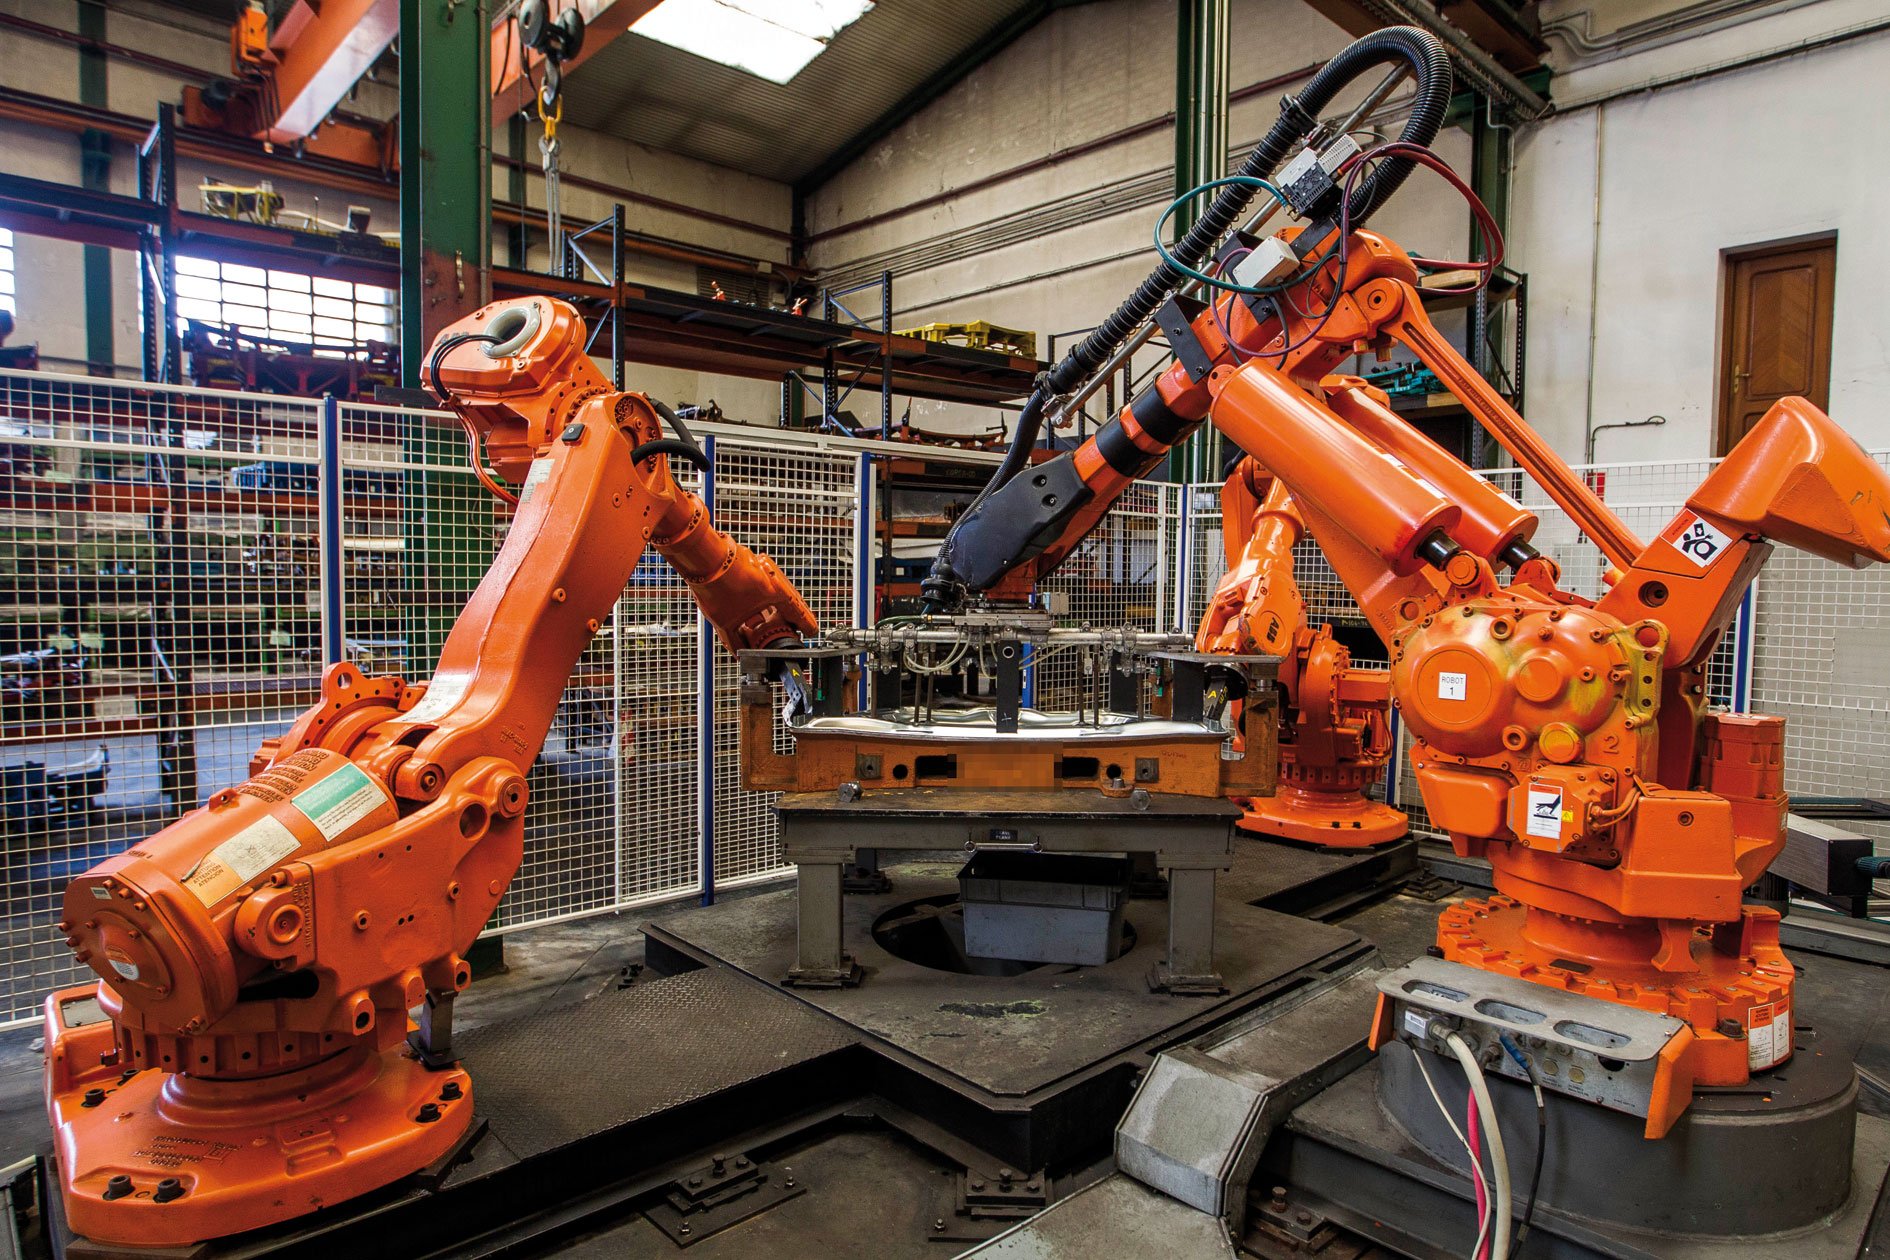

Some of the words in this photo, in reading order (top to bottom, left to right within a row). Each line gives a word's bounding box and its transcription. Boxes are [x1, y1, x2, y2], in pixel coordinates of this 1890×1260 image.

[1266, 616, 1279, 643] ABB
[792, 668, 800, 677] A
[1441, 676, 1464, 684] ROBOT
[1207, 690, 1217, 699] A
[1449, 686, 1454, 696] 1
[1603, 735, 1619, 754] 2
[193, 863, 221, 884] ATTENTION
